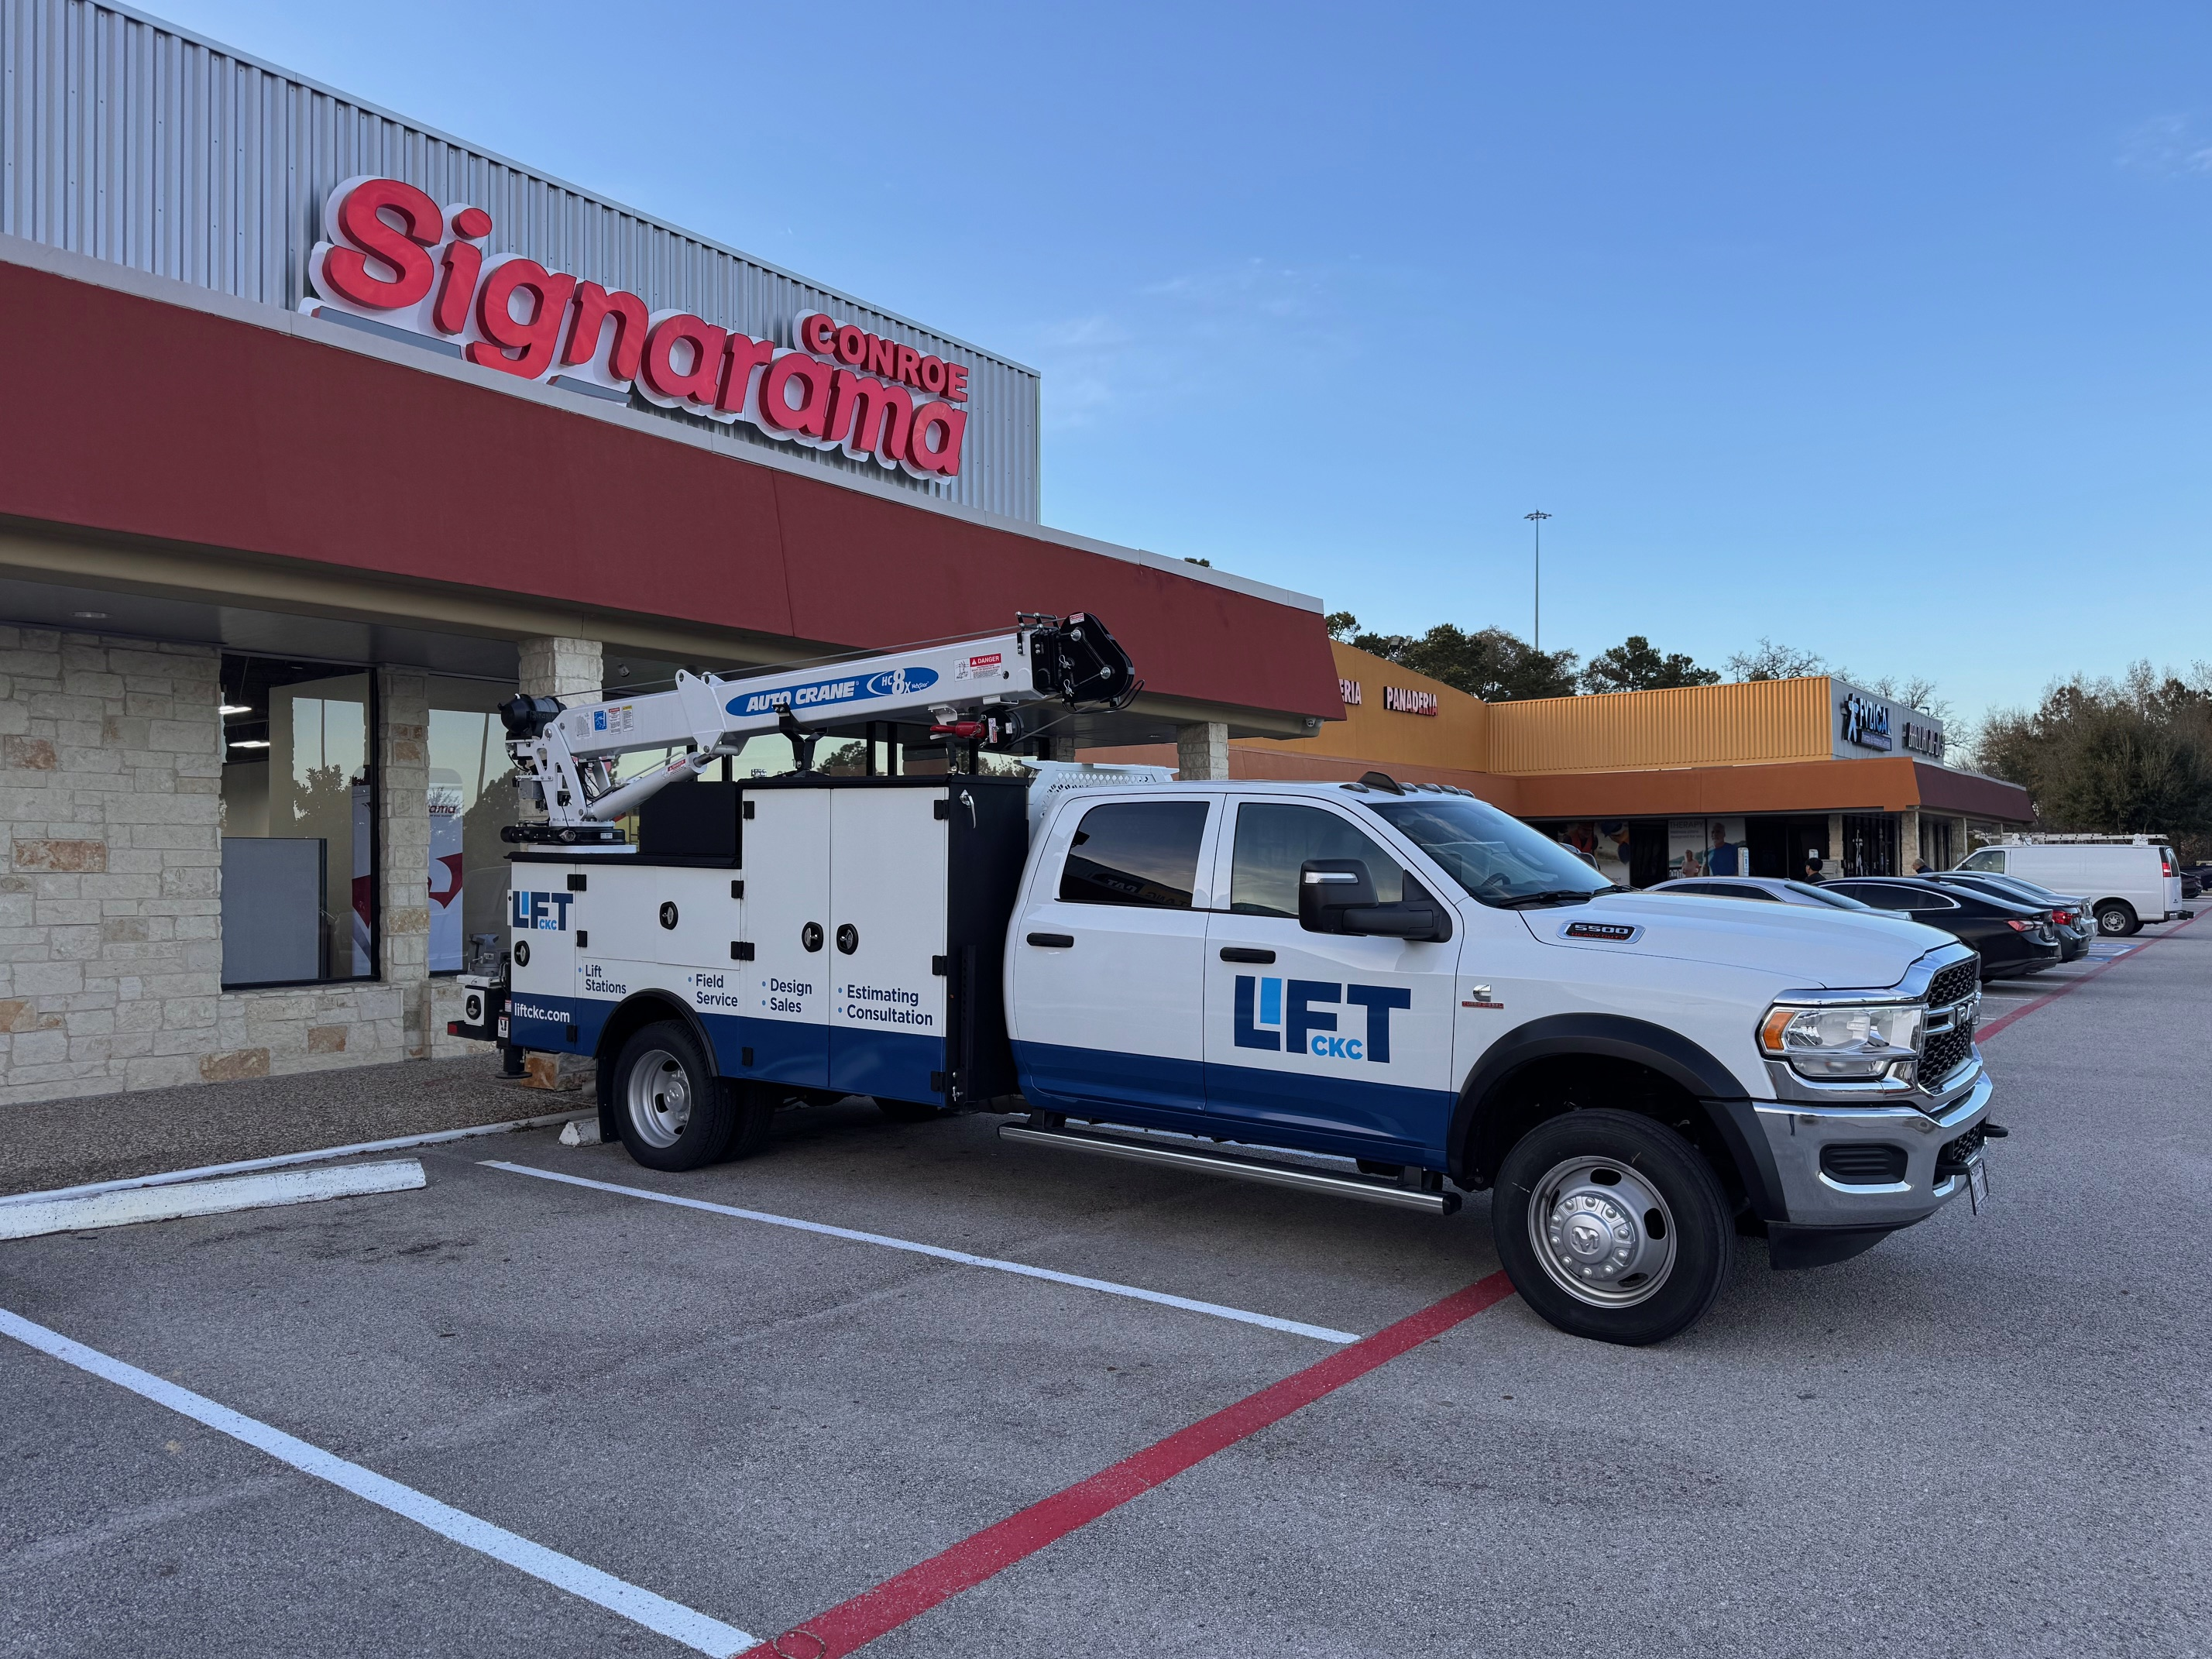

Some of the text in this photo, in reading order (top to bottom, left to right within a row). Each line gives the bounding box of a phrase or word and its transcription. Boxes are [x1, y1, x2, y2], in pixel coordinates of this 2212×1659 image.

[321, 177, 967, 478] Signarama
[801, 312, 970, 403] CONROE
[977, 655, 1000, 664] DANGER
[746, 691, 792, 713] AUTO
[1386, 685, 1438, 716] PANADERIA
[1859, 697, 1891, 736] FYZICAL
[1670, 821, 1704, 830] THERAPY
[512, 890, 574, 931] LIFT
[538, 919, 558, 930] CKC
[1575, 924, 1629, 935] 5500
[585, 964, 603, 978] Lift
[696, 974, 724, 988] Field
[585, 978, 627, 994] Stations
[770, 977, 813, 997] Design
[847, 984, 919, 1007] Estimating
[696, 991, 738, 1008] Service
[770, 997, 802, 1013] Sales
[514, 1002, 570, 1023] liftckc.com
[847, 1004, 933, 1026] Consultation
[1233, 974, 1412, 1064] LIFT
[1310, 1035, 1364, 1060] CKC
